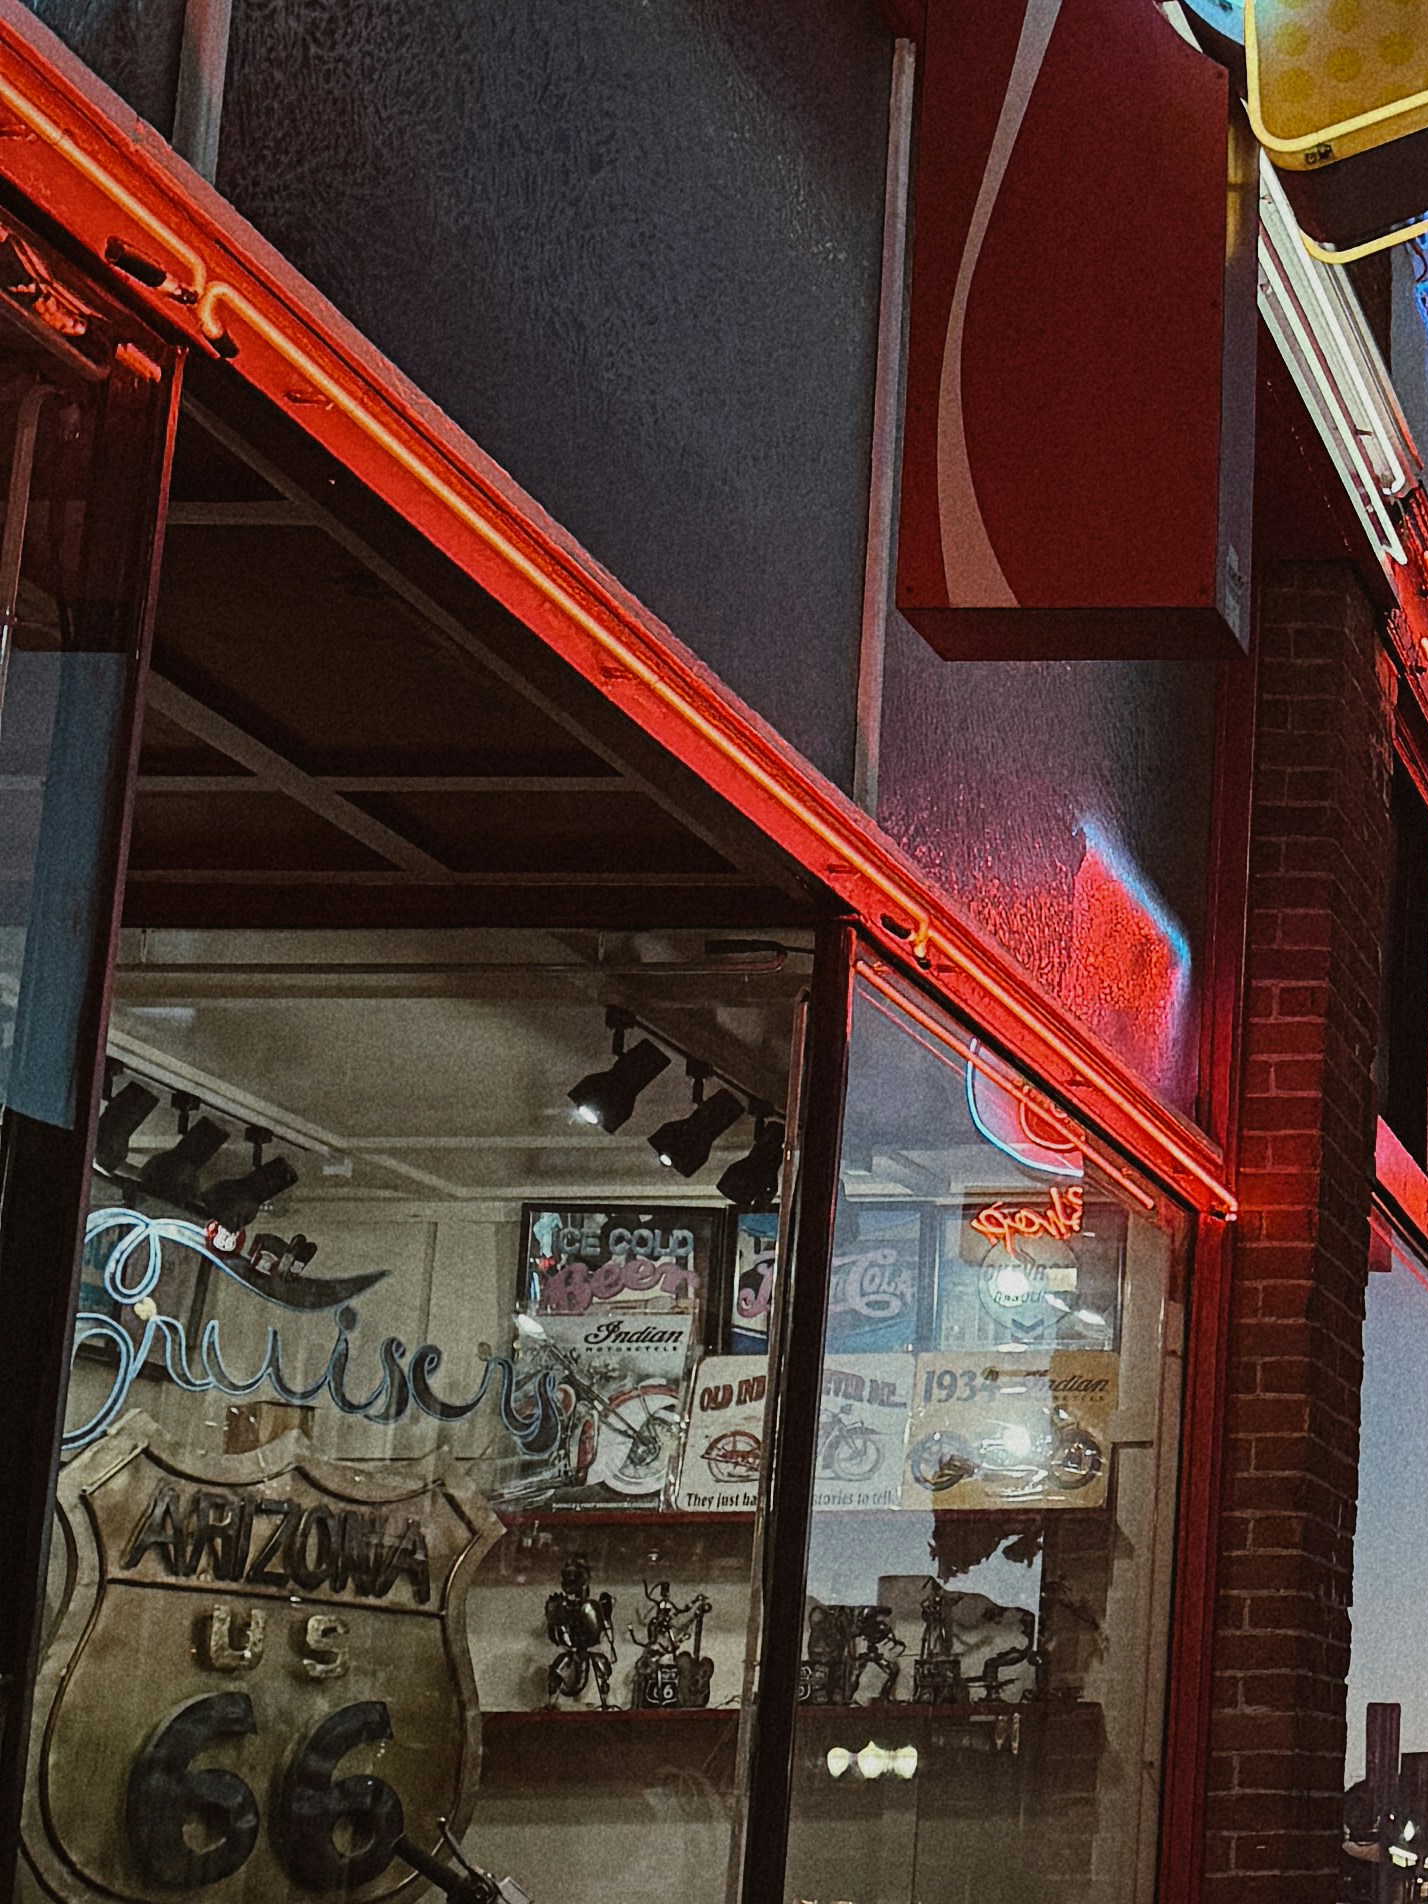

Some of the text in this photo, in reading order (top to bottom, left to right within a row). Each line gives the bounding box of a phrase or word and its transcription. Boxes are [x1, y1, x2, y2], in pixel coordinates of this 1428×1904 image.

[552, 1227, 695, 1257] ICE COLD
[540, 1259, 701, 1313] Beer
[584, 1319, 683, 1345] Indian
[585, 1345, 679, 1353] MOTORCYCLE
[700, 1383, 733, 1412] OLD
[922, 1370, 998, 1402] 1934
[686, 1492, 713, 1509] They
[716, 1492, 734, 1508] just
[737, 1493, 757, 1506] ha
[857, 1492, 870, 1505] to
[123, 1477, 433, 1604] ARIZONA
[126, 1691, 405, 1892] 66
